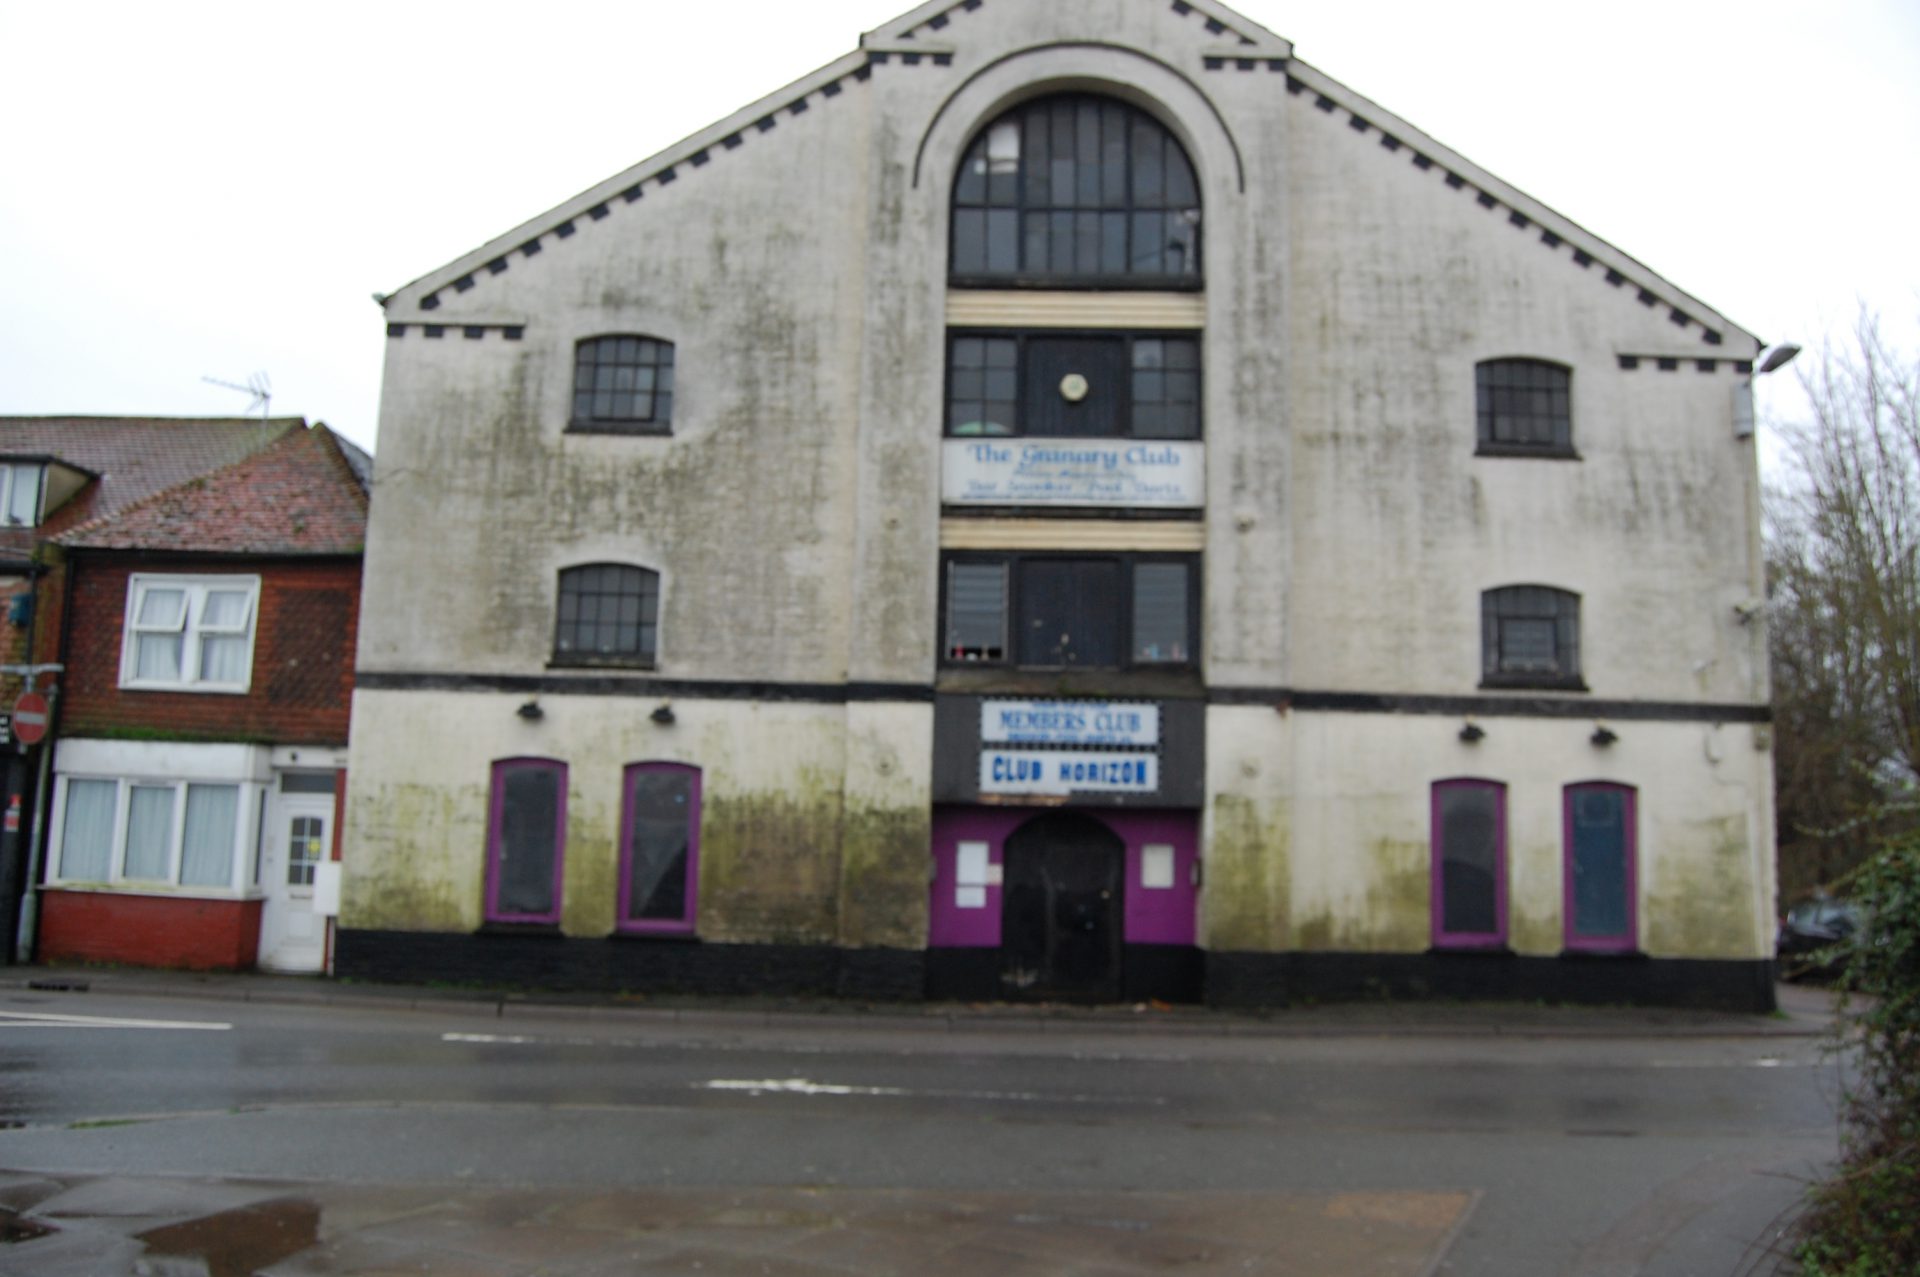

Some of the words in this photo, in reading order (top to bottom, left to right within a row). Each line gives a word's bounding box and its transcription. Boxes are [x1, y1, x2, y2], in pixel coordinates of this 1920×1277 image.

[966, 443, 1011, 464] The
[1020, 444, 1118, 470] Granary
[1125, 445, 1181, 466] Club
[1000, 710, 1086, 730] MEMBERS
[1094, 712, 1141, 732] CLUB
[993, 756, 1042, 782] CLUB
[1059, 759, 1146, 785] HORIZON
